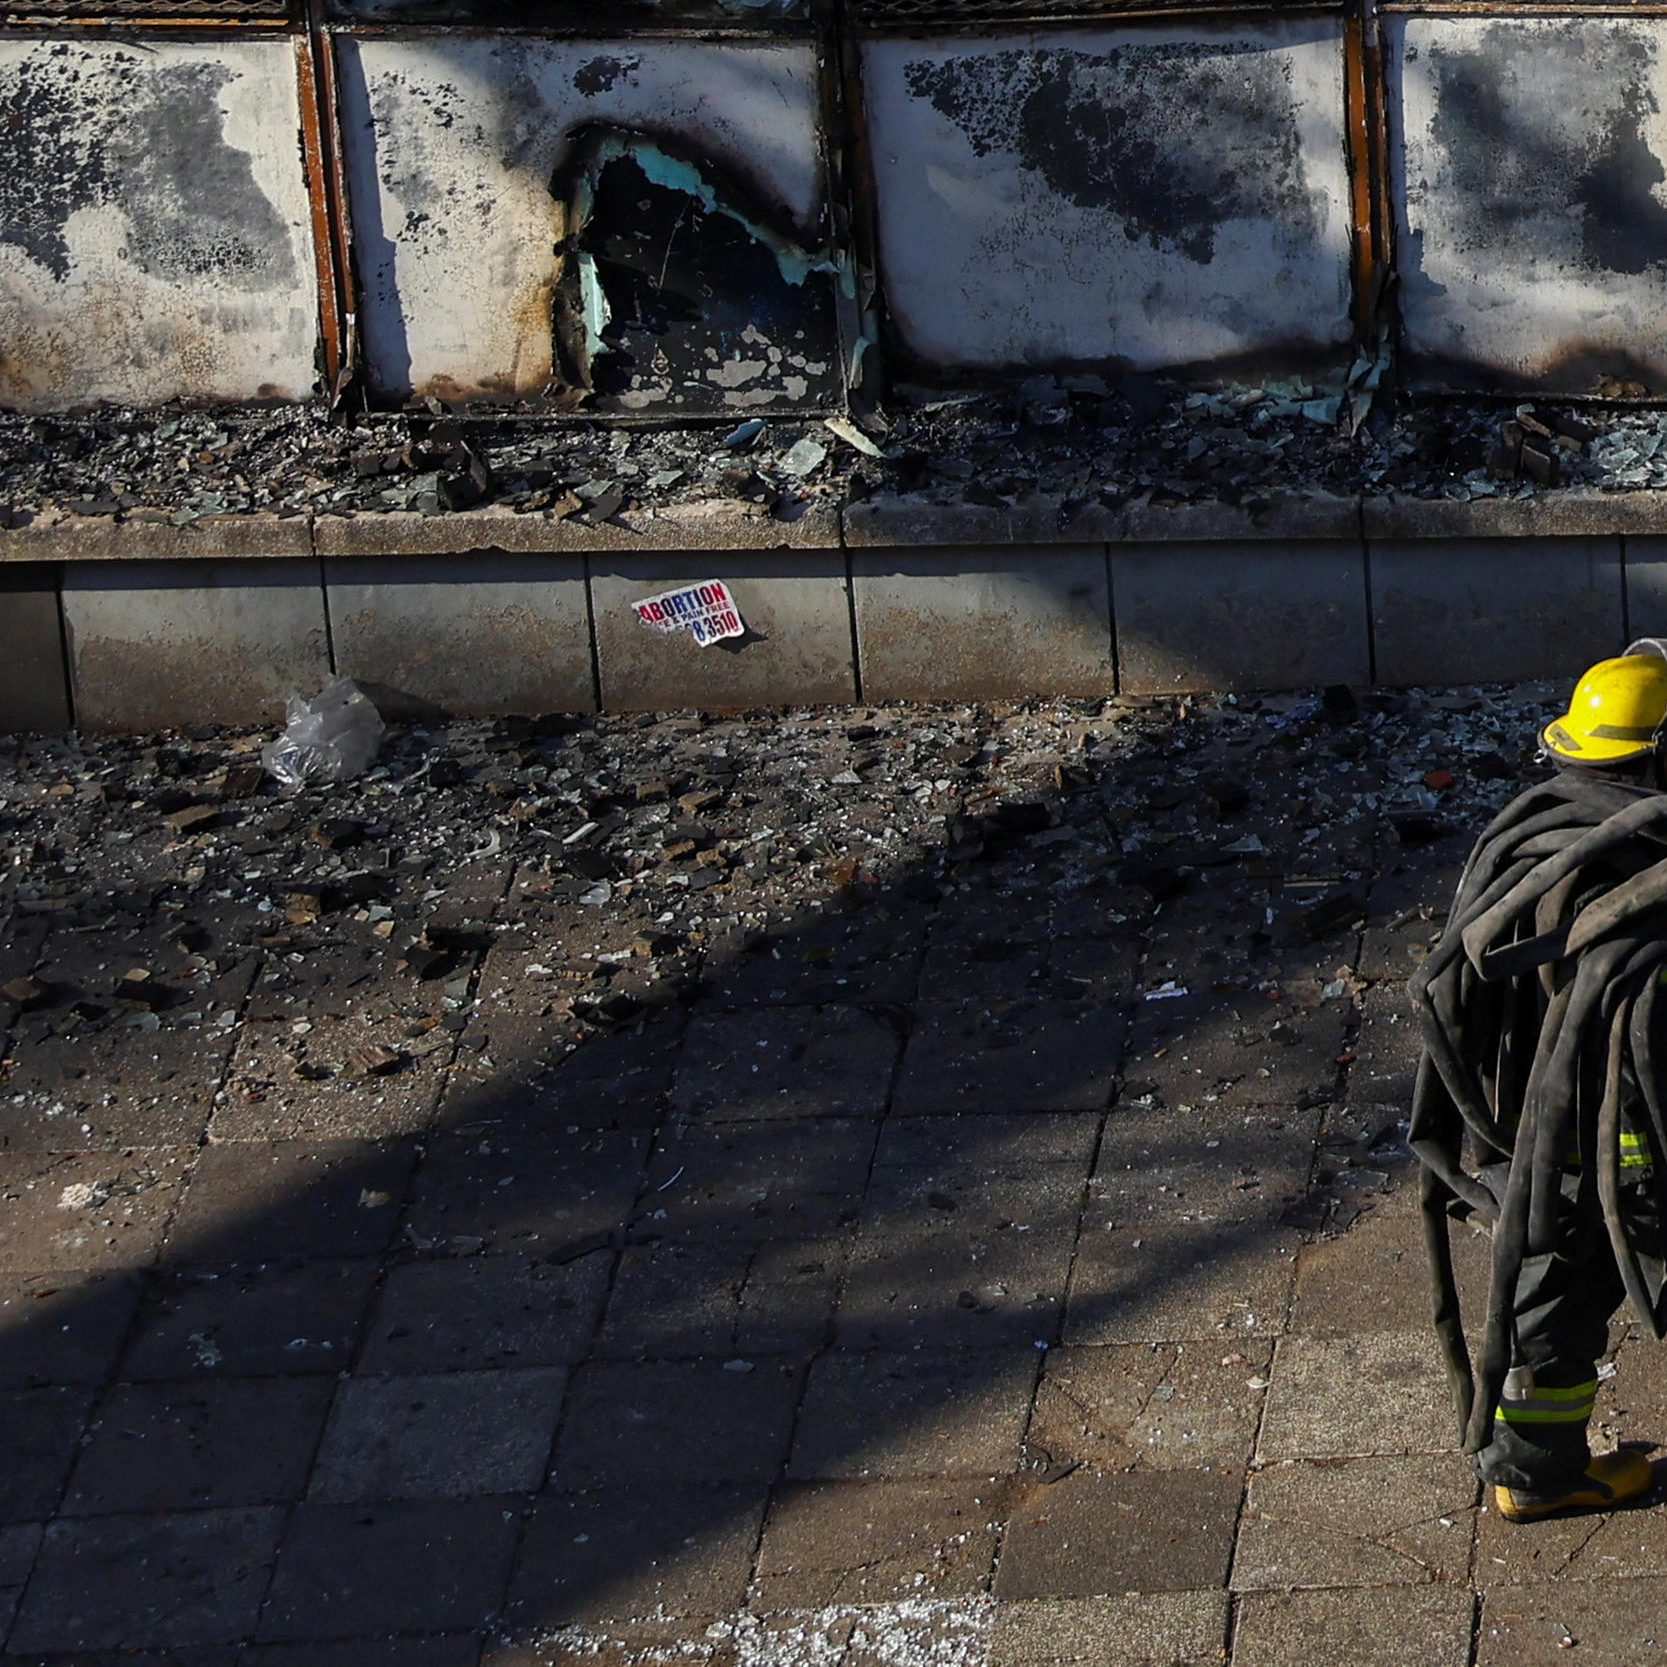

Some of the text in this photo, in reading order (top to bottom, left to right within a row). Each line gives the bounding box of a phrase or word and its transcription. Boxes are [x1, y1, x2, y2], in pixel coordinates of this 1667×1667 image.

[638, 582, 727, 623] ABORTION
[681, 609, 705, 622] PAIN
[706, 601, 731, 615] FREE
[703, 611, 739, 638] 3510
